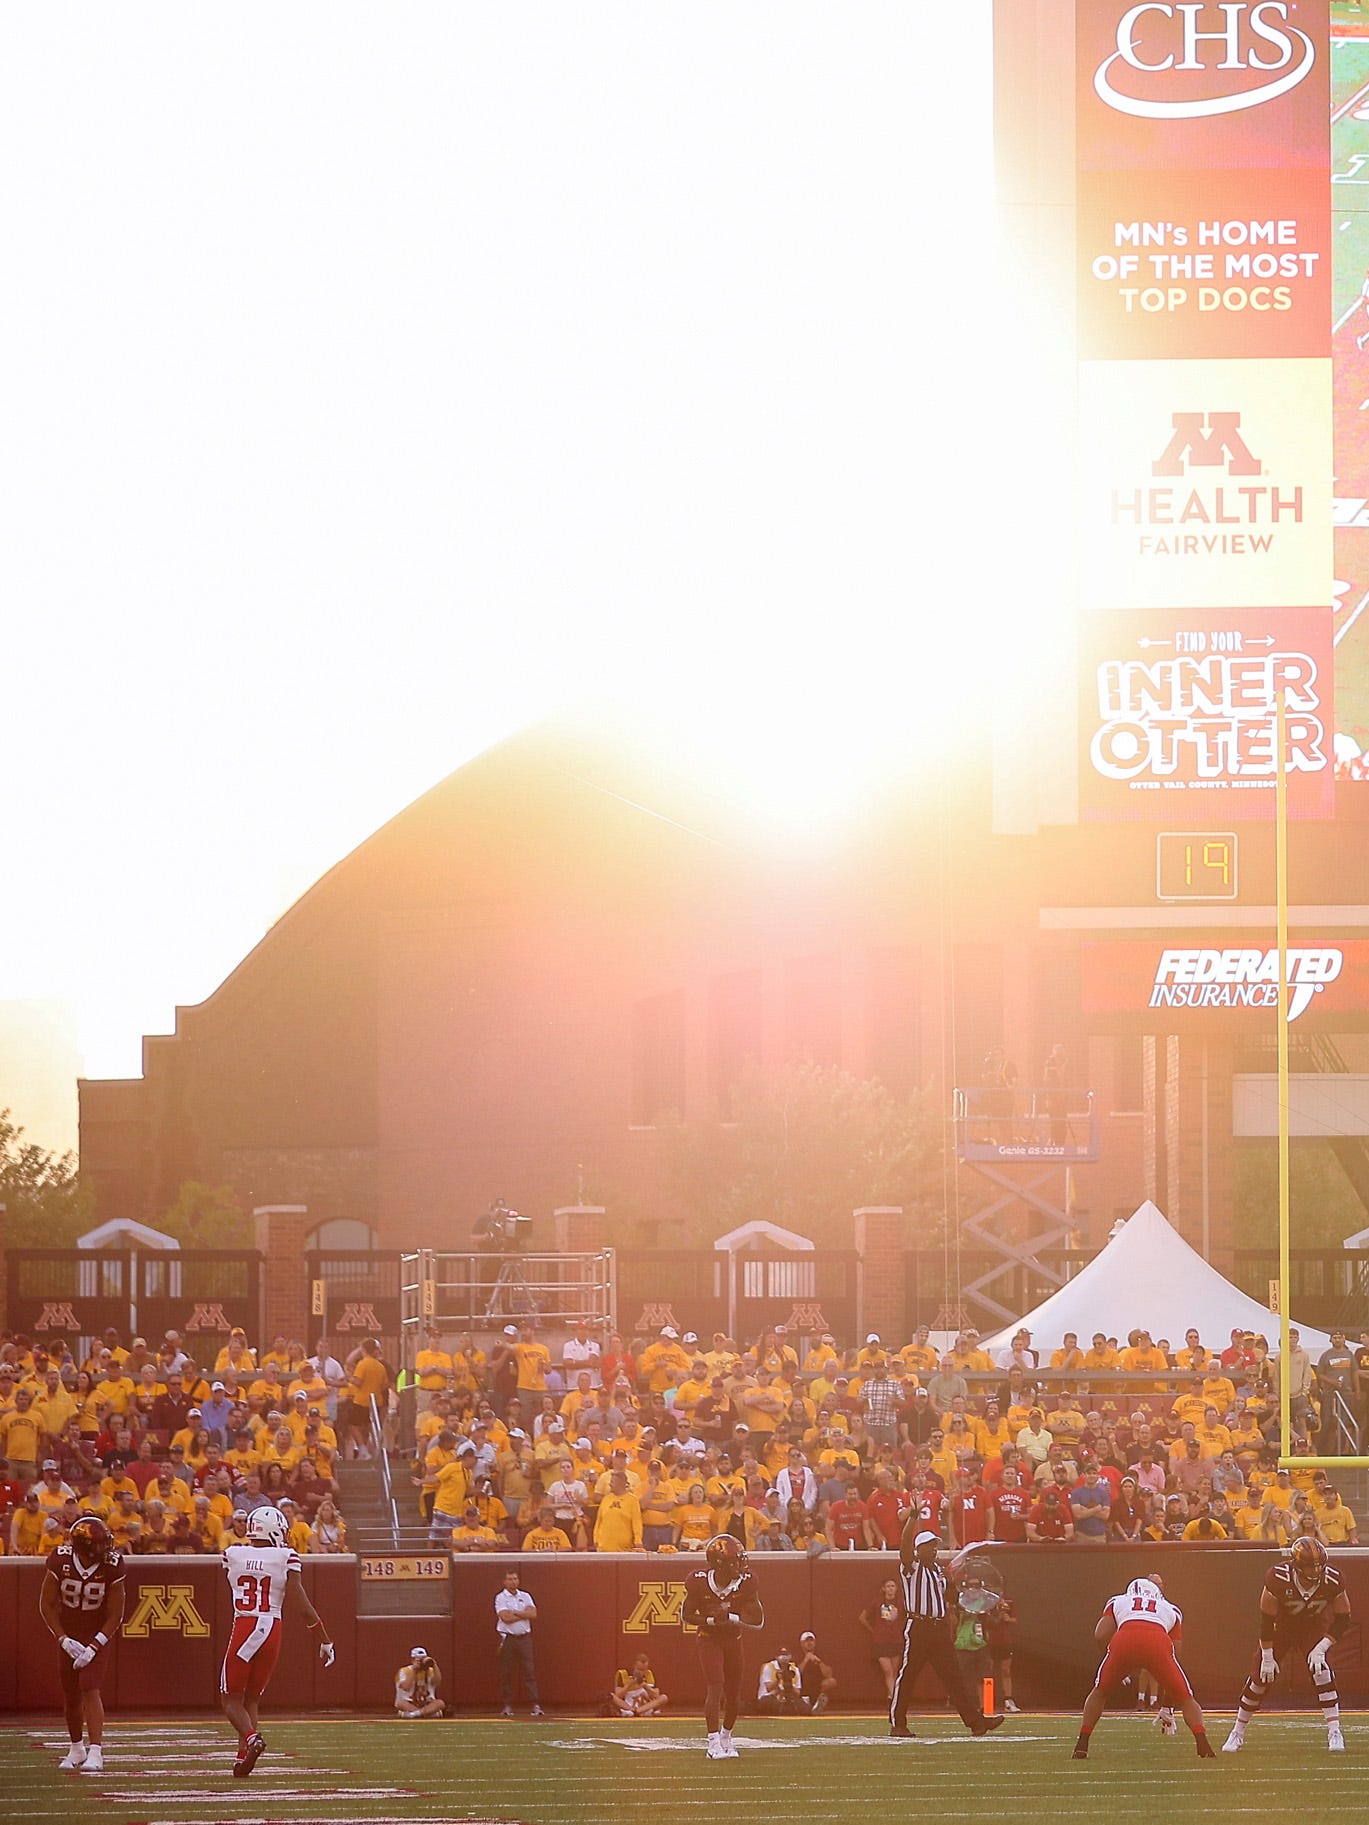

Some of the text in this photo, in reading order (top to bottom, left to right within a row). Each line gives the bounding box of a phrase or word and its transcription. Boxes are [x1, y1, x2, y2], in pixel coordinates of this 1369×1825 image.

[1116, 0, 1294, 72] CHS
[1114, 220, 1297, 247] MN's HOME
[1091, 252, 1320, 281] OF THE MOST
[1119, 286, 1293, 313] TOP DOCS
[1110, 486, 1304, 525] HEALTH
[1138, 533, 1275, 556] FAIRVIEW
[1175, 631, 1244, 652] FIND YOUR
[1096, 652, 1320, 720] INNER
[1090, 711, 1328, 780] OTTER
[1231, 780, 1287, 788] MINNESO
[1184, 842, 1230, 886] 19
[1154, 948, 1343, 998] FEDERATED
[1148, 983, 1279, 1008] INSURANCE
[998, 1145, 1027, 1156] Genie
[245, 1560, 264, 1571] HILL
[366, 1561, 394, 1576] 148
[416, 1561, 444, 1575] 149
[60, 1578, 106, 1611] 88
[234, 1575, 272, 1613] 31
[1131, 1597, 1157, 1613] 11
